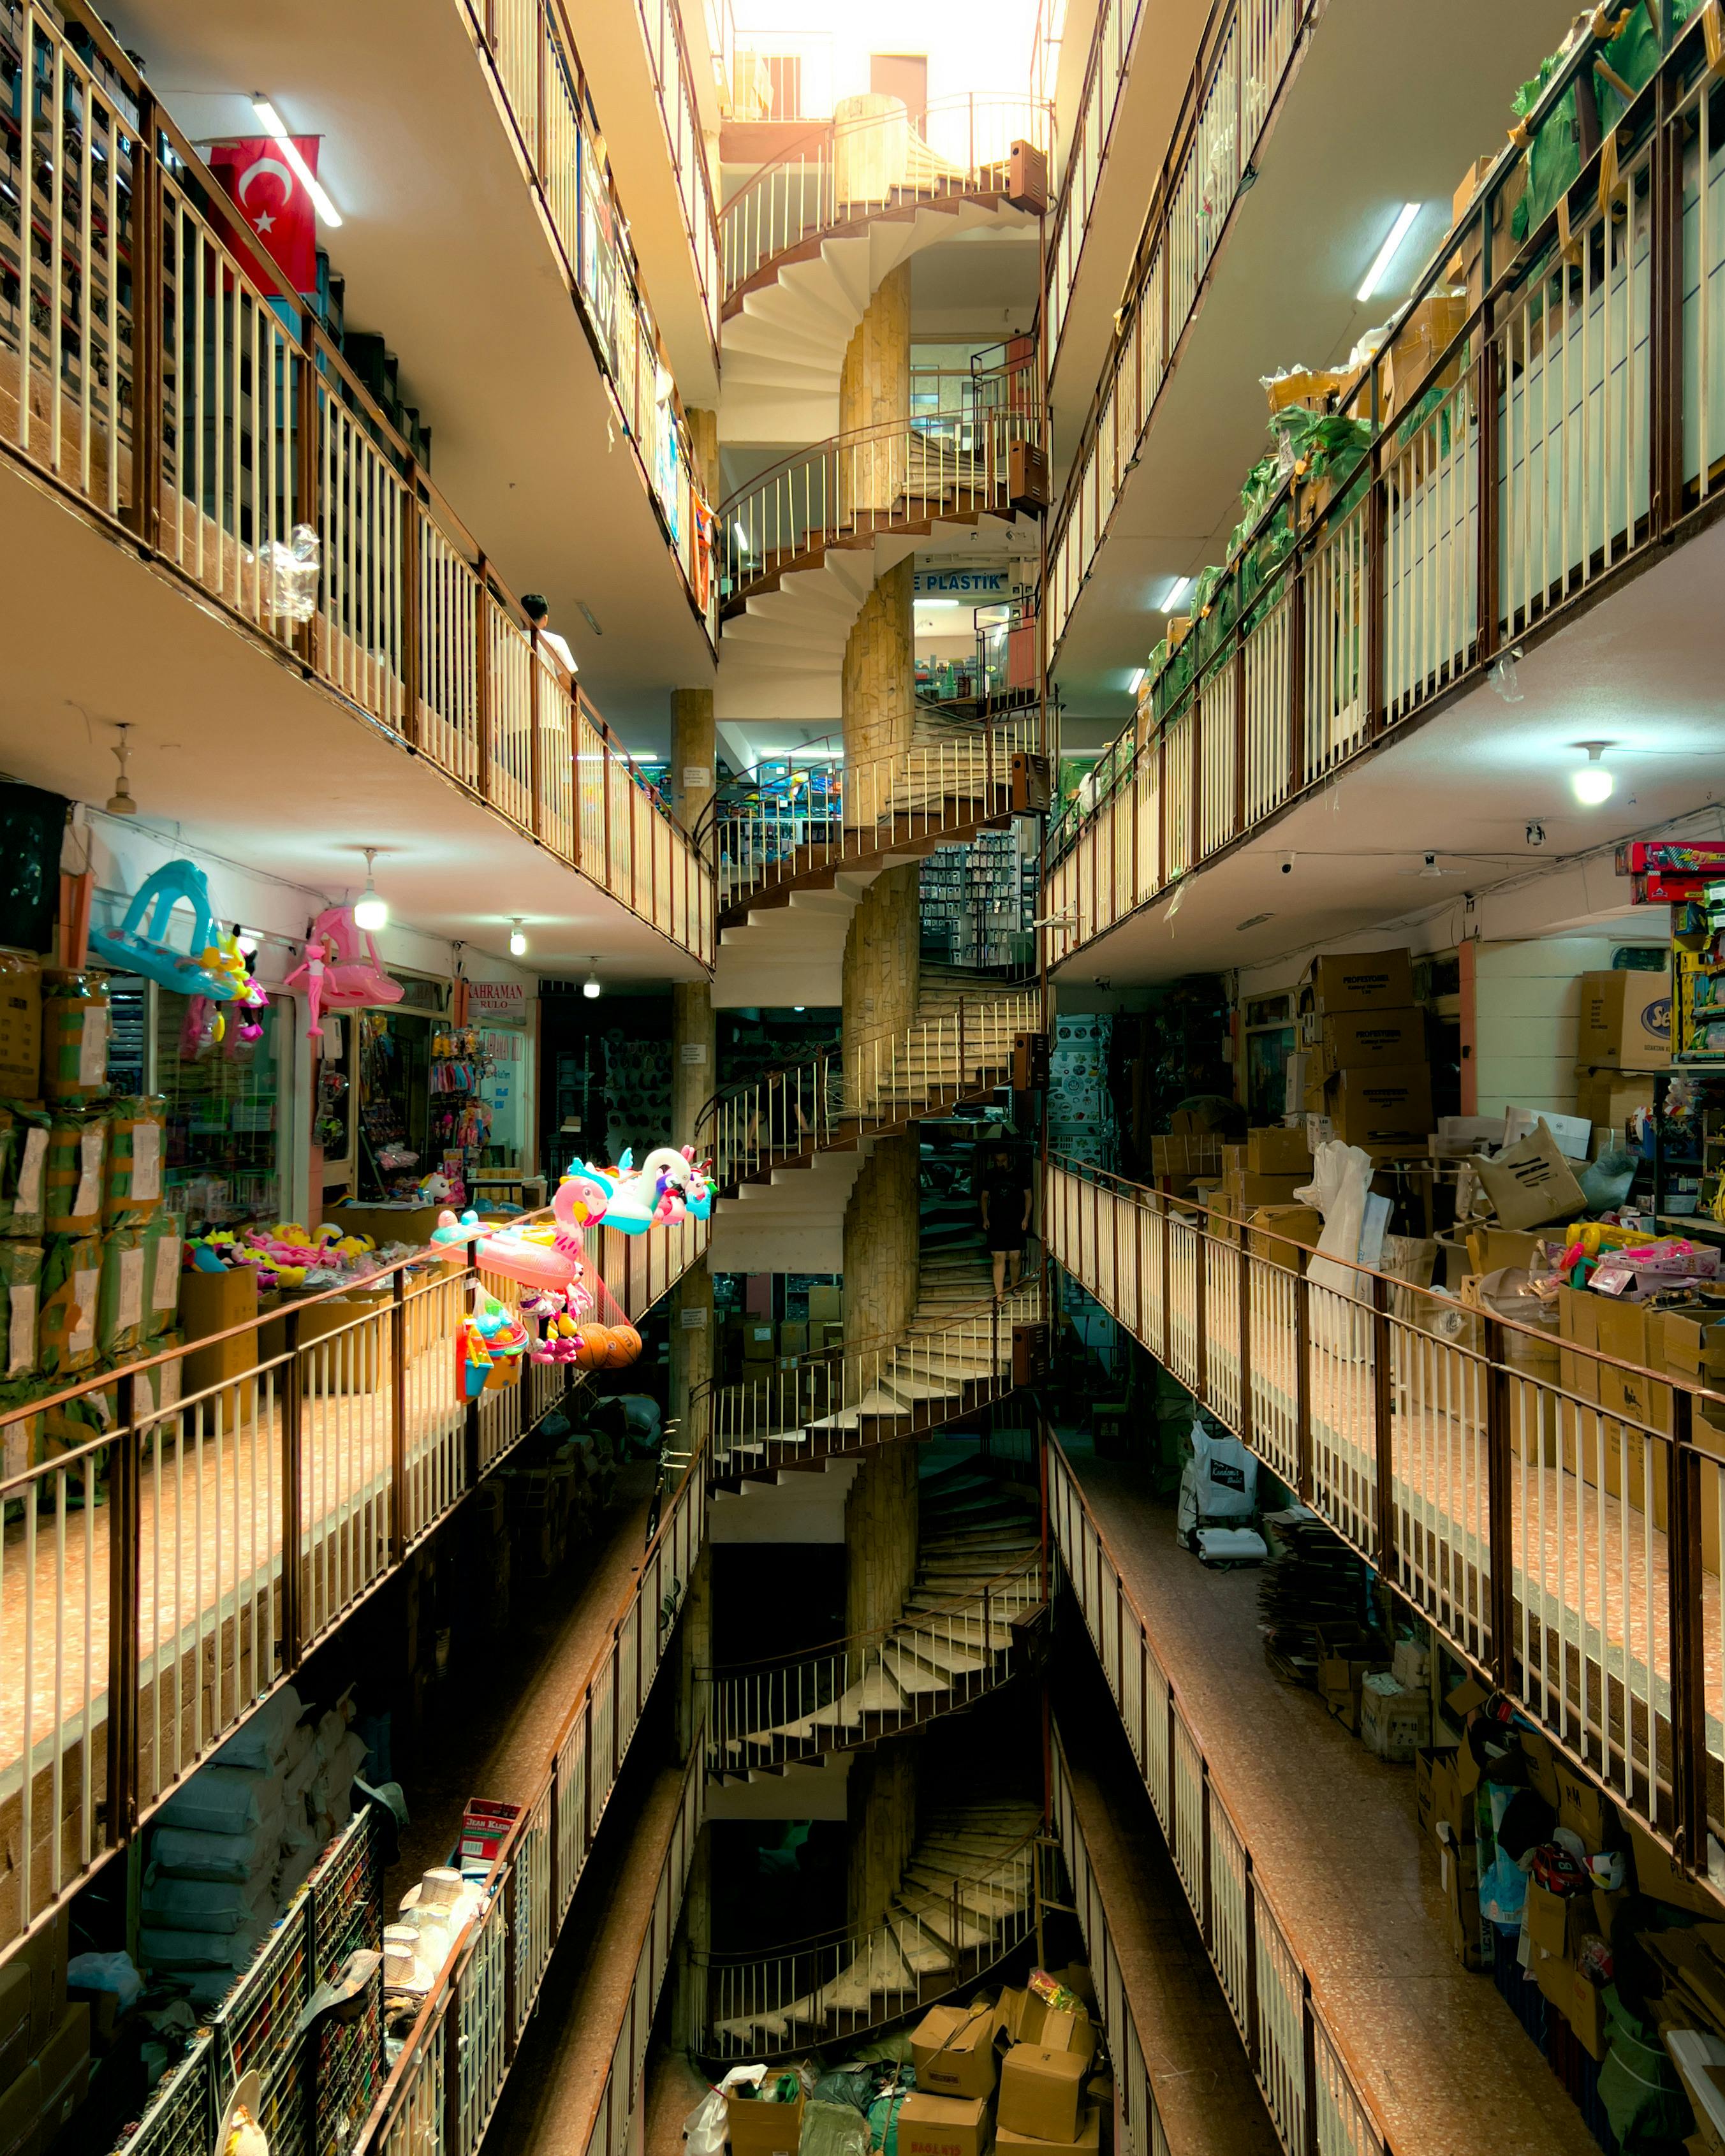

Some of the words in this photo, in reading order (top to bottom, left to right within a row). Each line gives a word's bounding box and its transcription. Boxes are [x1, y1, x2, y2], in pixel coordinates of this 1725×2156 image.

[927, 573, 1001, 590] PLASTİK
[468, 984, 523, 999] KAHRAMAN
[480, 1001, 508, 1009] RULO
[1652, 1005, 1671, 1028] Se
[466, 1818, 486, 1827] JEAN
